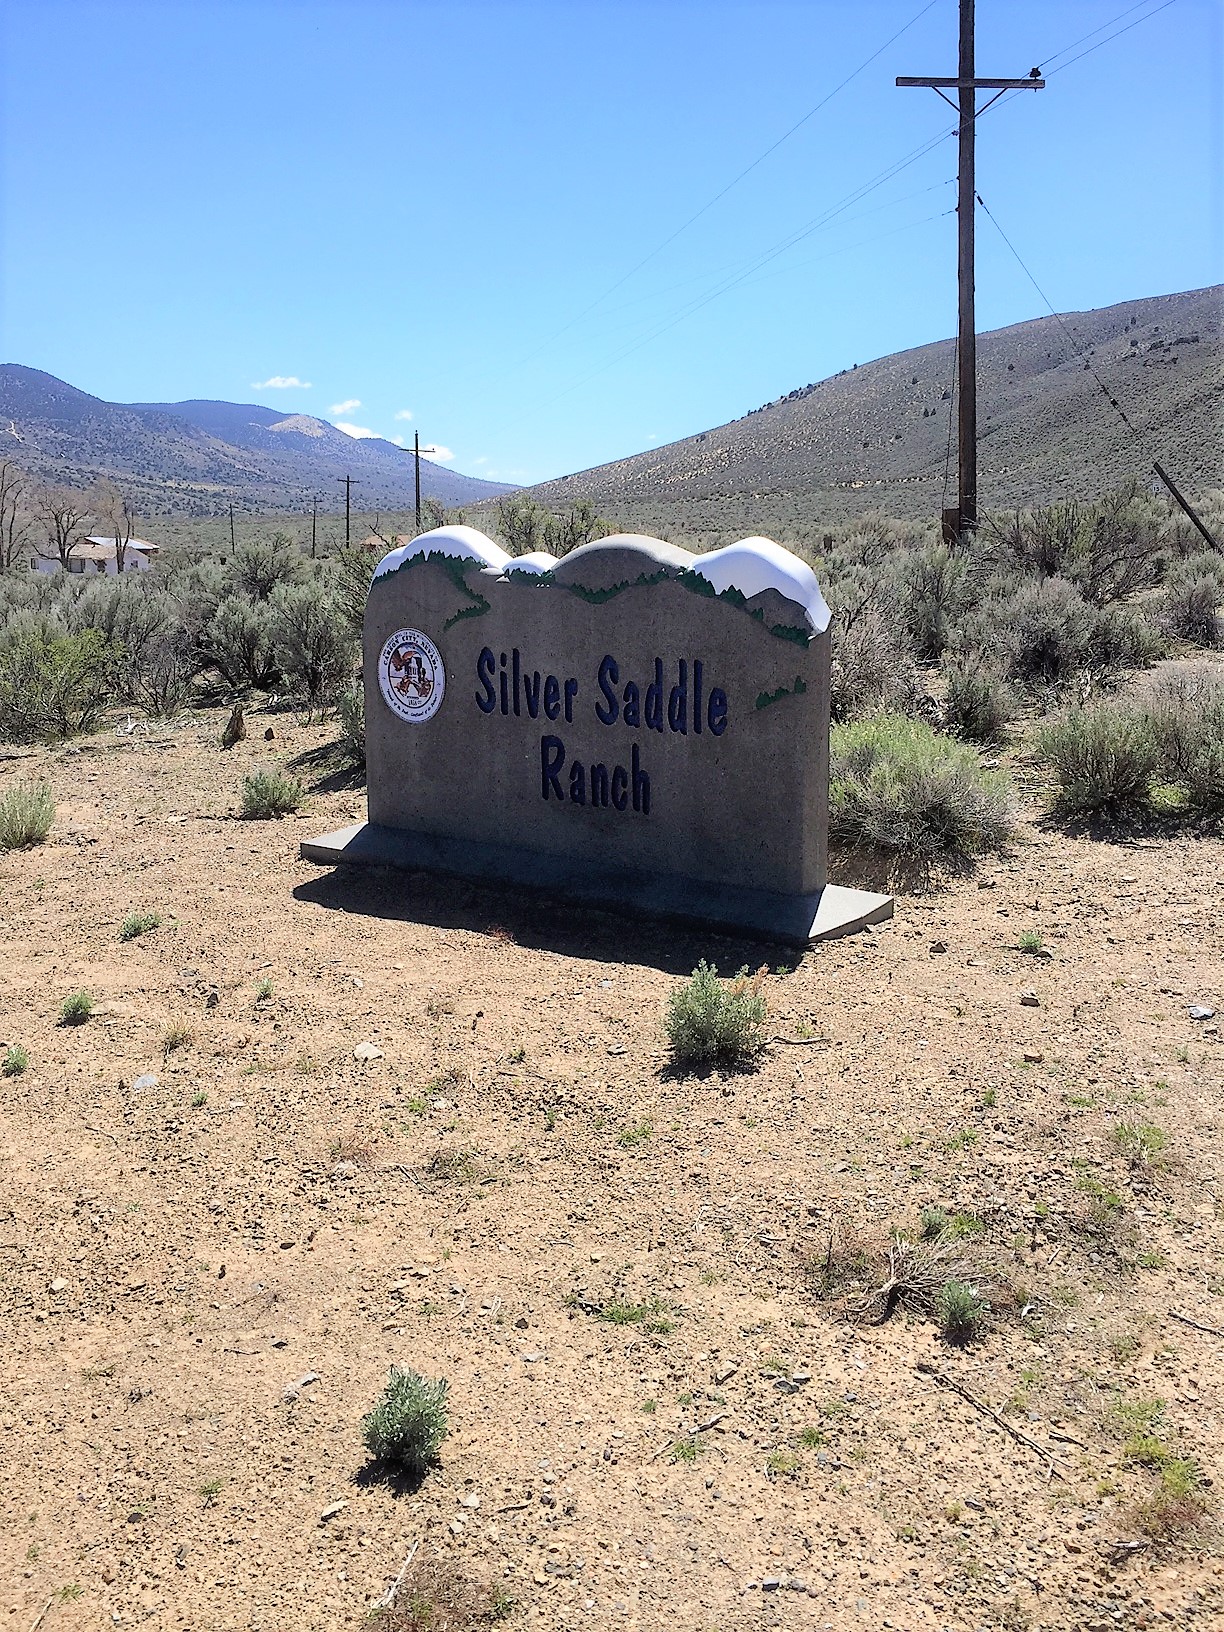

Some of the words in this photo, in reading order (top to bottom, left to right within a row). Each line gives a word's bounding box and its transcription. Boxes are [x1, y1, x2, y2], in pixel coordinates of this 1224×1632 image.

[421, 641, 438, 670] NEVADA
[475, 646, 578, 723] Silver
[595, 654, 728, 736] Saddle
[541, 734, 650, 815] Ranch
